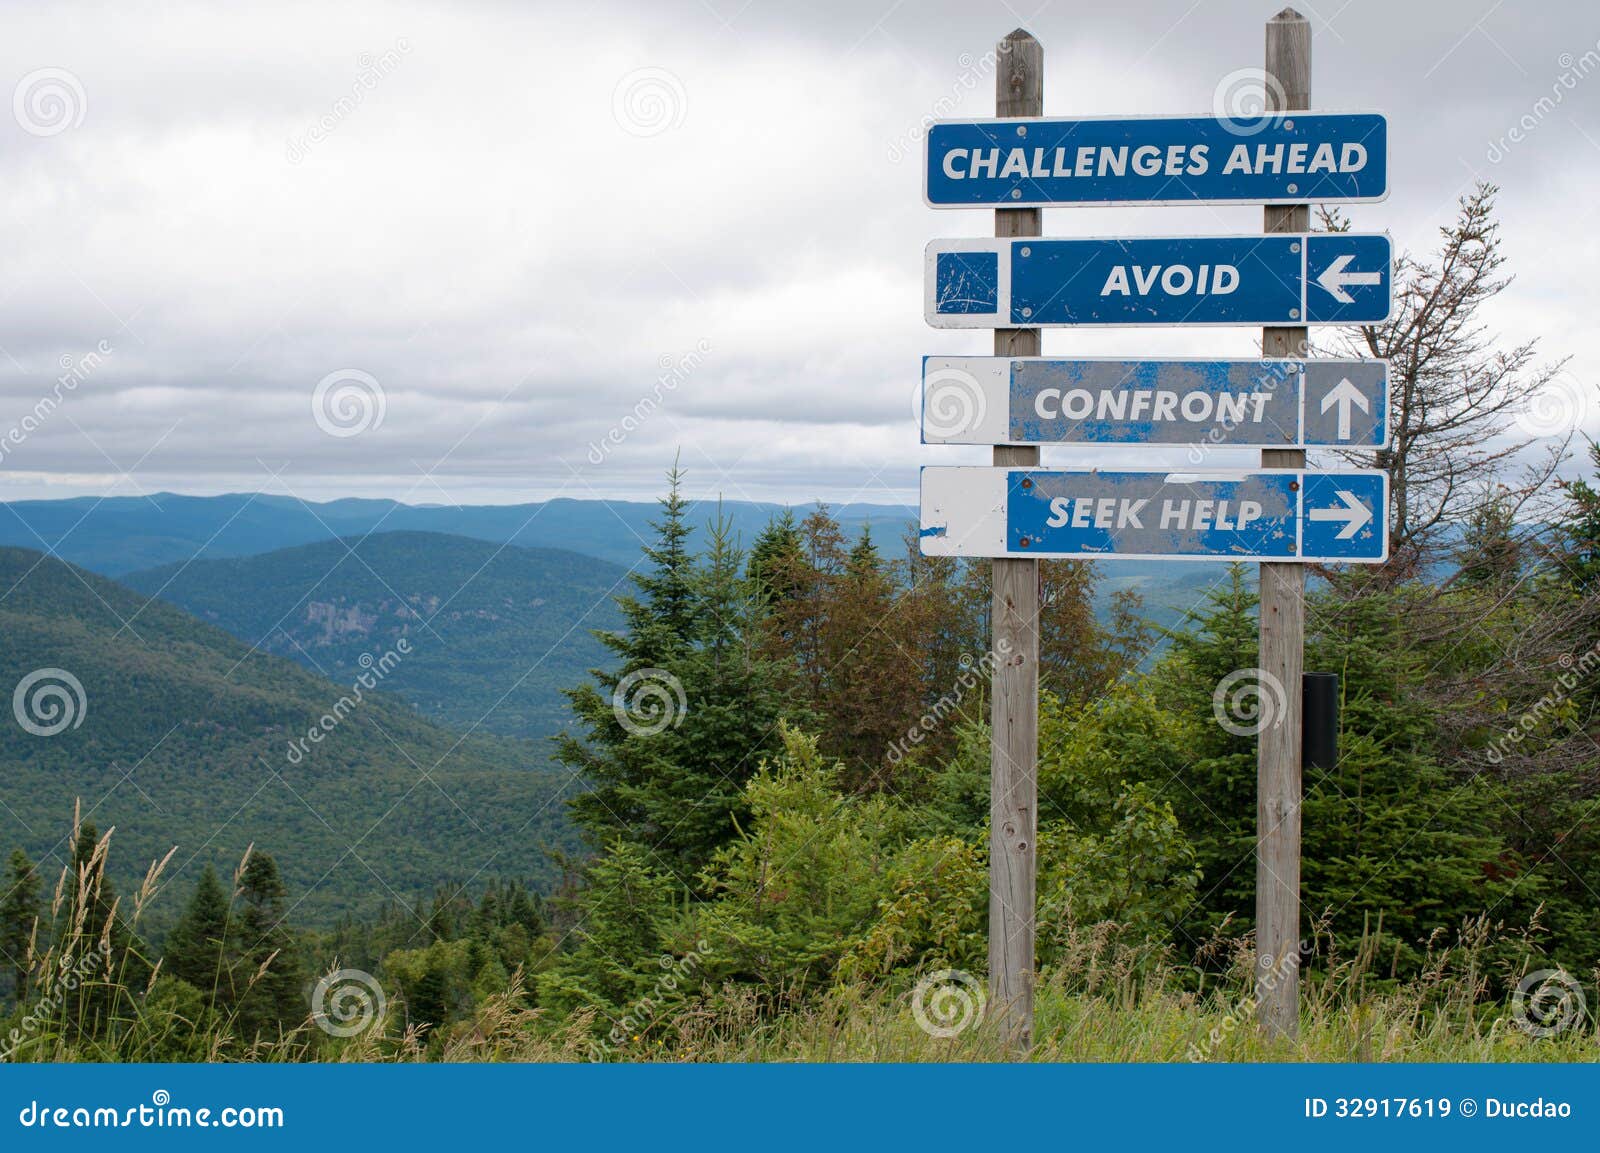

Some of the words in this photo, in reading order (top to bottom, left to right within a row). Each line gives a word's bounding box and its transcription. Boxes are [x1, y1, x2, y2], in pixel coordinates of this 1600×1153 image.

[942, 145, 1210, 180] CHALLENGES
[1222, 142, 1368, 175] AHEAD
[1100, 264, 1241, 297] AVOID
[1034, 388, 1272, 423] CONFRONT
[1046, 496, 1145, 530] SEEK
[1159, 498, 1264, 531] HELP
